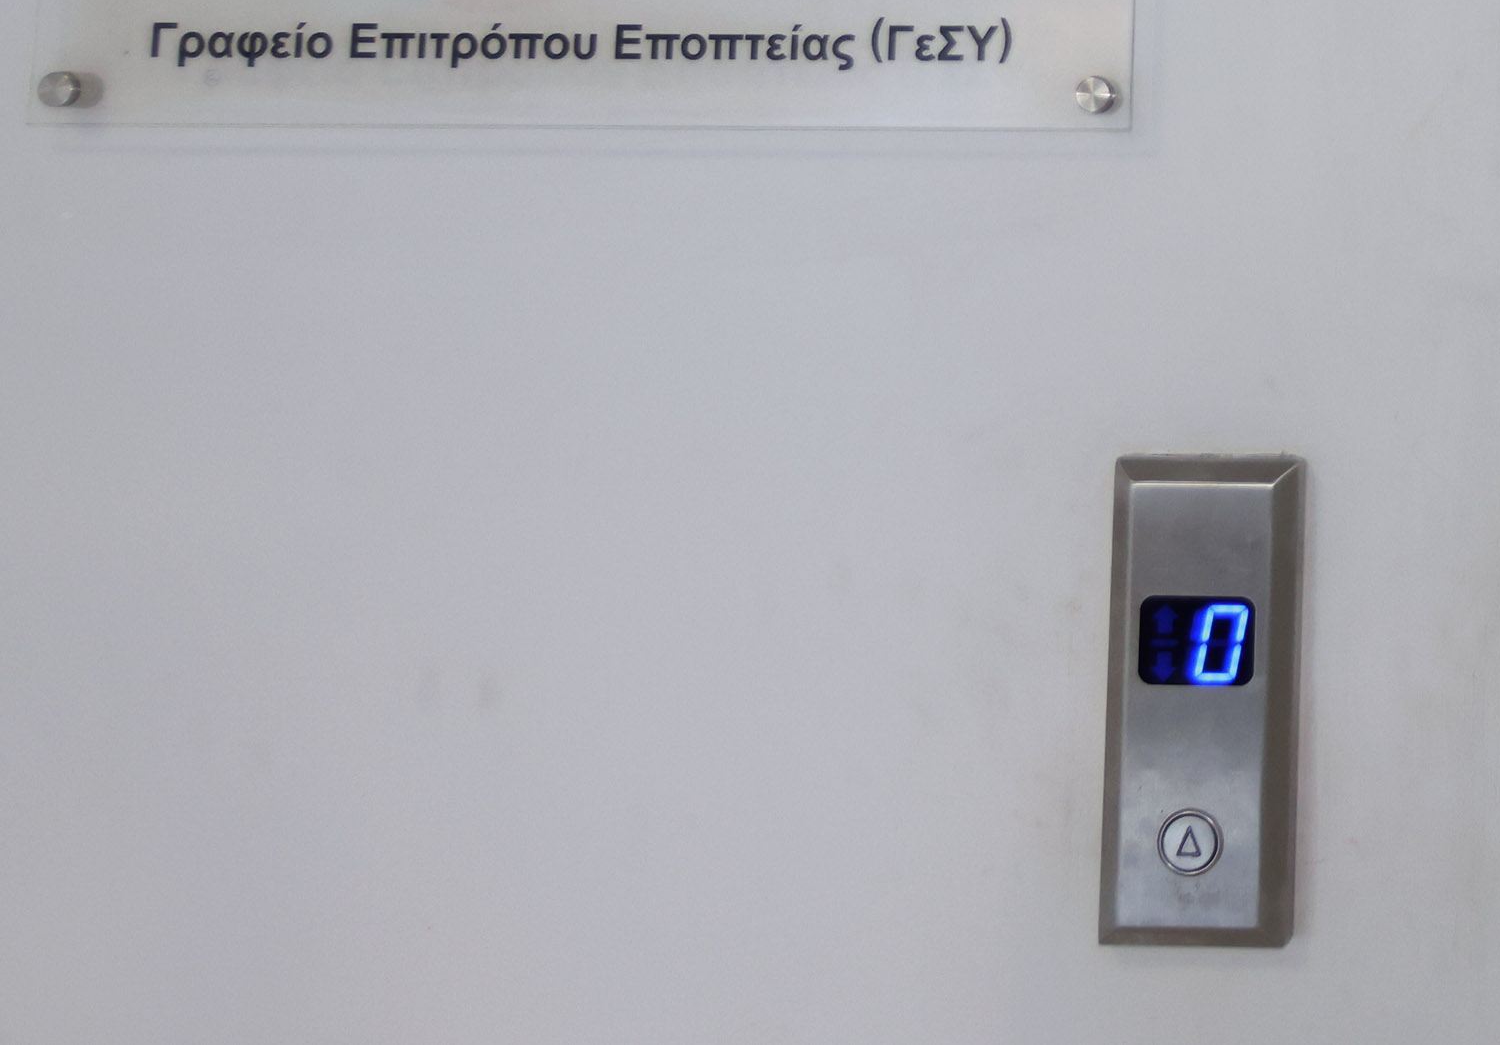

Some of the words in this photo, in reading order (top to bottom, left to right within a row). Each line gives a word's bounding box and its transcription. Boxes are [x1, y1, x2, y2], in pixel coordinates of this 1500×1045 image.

[150, 21, 334, 67] Γραφείο
[349, 22, 598, 67] Επιτρόπου
[613, 21, 854, 70] Εποπτείας
[870, 17, 1012, 65] (ΓεΣΥ)
[1193, 603, 1250, 683] 0
